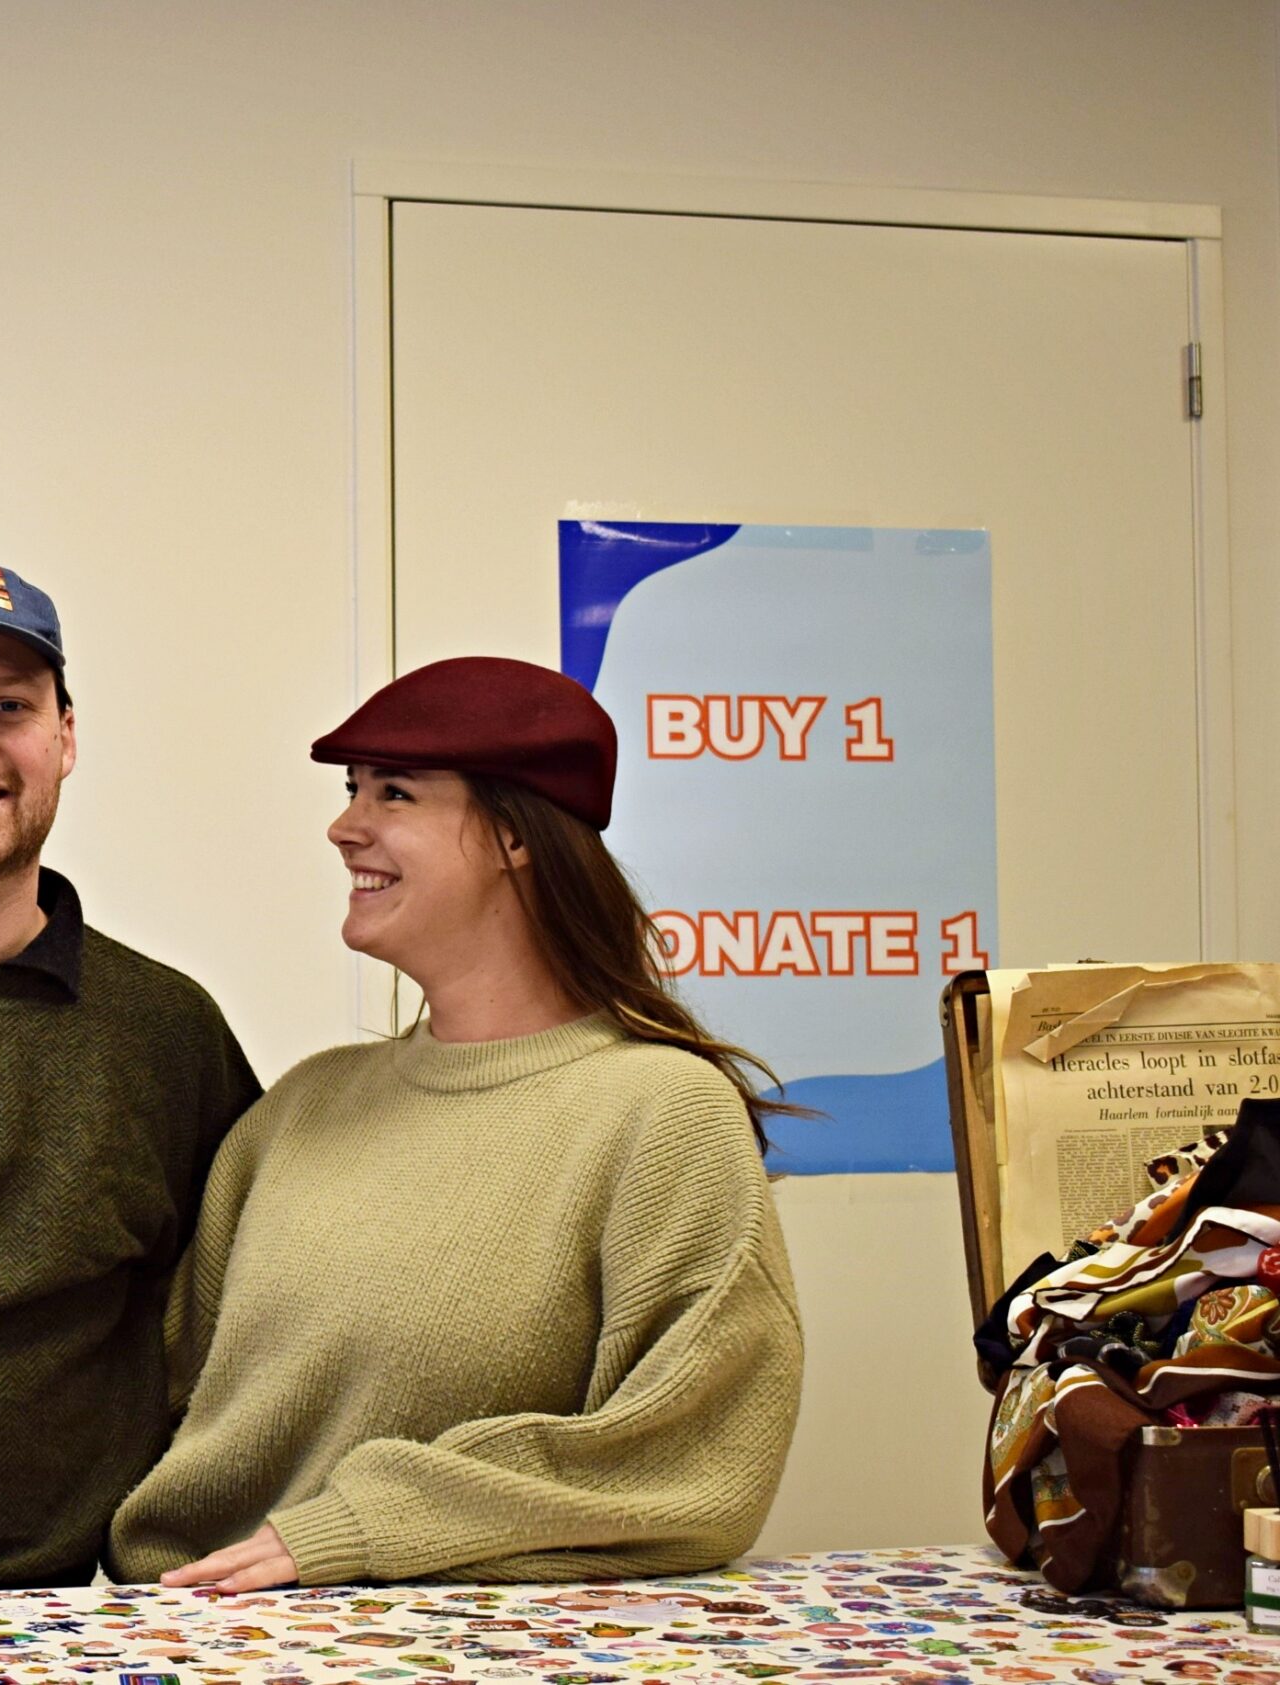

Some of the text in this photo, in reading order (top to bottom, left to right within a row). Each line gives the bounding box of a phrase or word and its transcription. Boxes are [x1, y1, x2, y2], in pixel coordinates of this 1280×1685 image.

[647, 694, 894, 762] BUY 1
[648, 910, 989, 977] ONATE 1
[1106, 1034, 1116, 1042] IN
[1119, 1032, 1154, 1042] EERSTE
[1158, 1031, 1192, 1041] DIVISIE
[1194, 1030, 1215, 1039] VAN
[1217, 1028, 1259, 1038] SLECHTE
[1051, 1052, 1130, 1072] Heracles
[1141, 1050, 1187, 1075] loopt
[1198, 1049, 1216, 1067] in
[1087, 1077, 1194, 1100] achterstand
[1205, 1083, 1238, 1095] van
[1099, 1107, 1148, 1121] Haarlem
[1155, 1105, 1214, 1120] fortuinlijk
